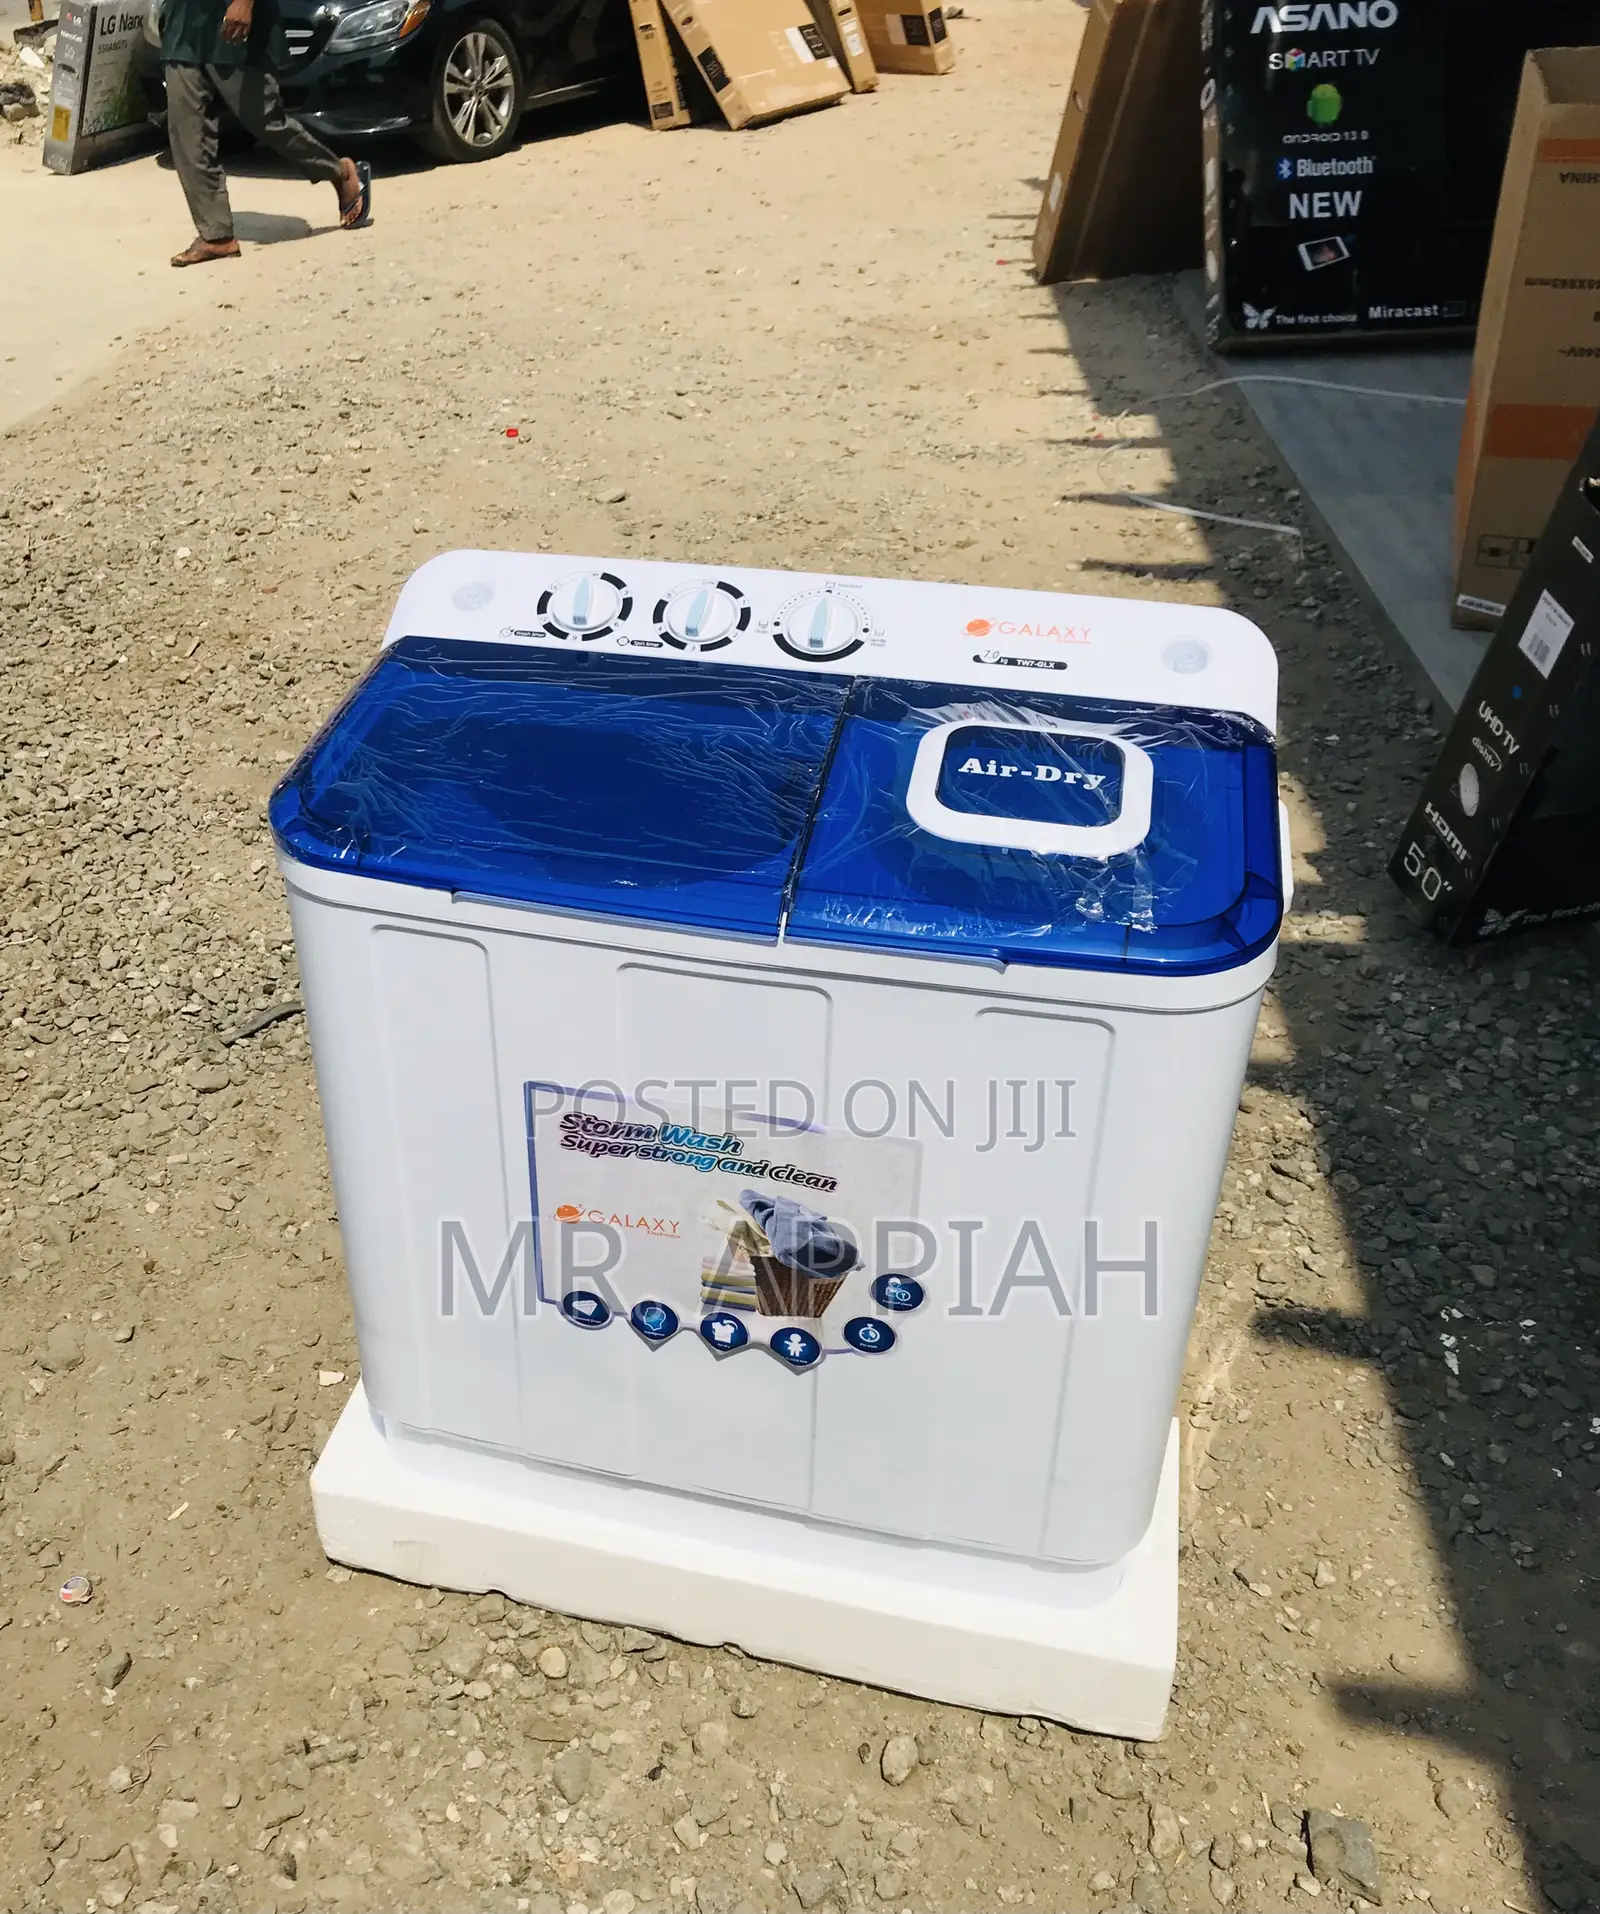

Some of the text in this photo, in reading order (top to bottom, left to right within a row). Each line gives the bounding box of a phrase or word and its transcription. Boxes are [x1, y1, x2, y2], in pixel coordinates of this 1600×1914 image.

[100, 15, 116, 36] LG
[1250, 0, 1399, 34] ASANO
[1268, 48, 1380, 71] SMART TV
[1297, 156, 1374, 177] Bluetooth
[1289, 190, 1363, 219] NEW
[1275, 314, 1295, 325] The
[1368, 304, 1440, 319] Miracast
[998, 620, 1092, 640] GALAXY
[983, 649, 1000, 660] 7.0
[1016, 659, 1056, 669] TW7-GLX
[1478, 700, 1521, 755] UHD TV
[957, 757, 1107, 791] Air-Dry
[1424, 801, 1468, 861] HDMI
[560, 1111, 745, 1156] Storm Wash
[560, 1132, 839, 1193] Super strong and clean
[587, 1210, 681, 1234] GALAXY
